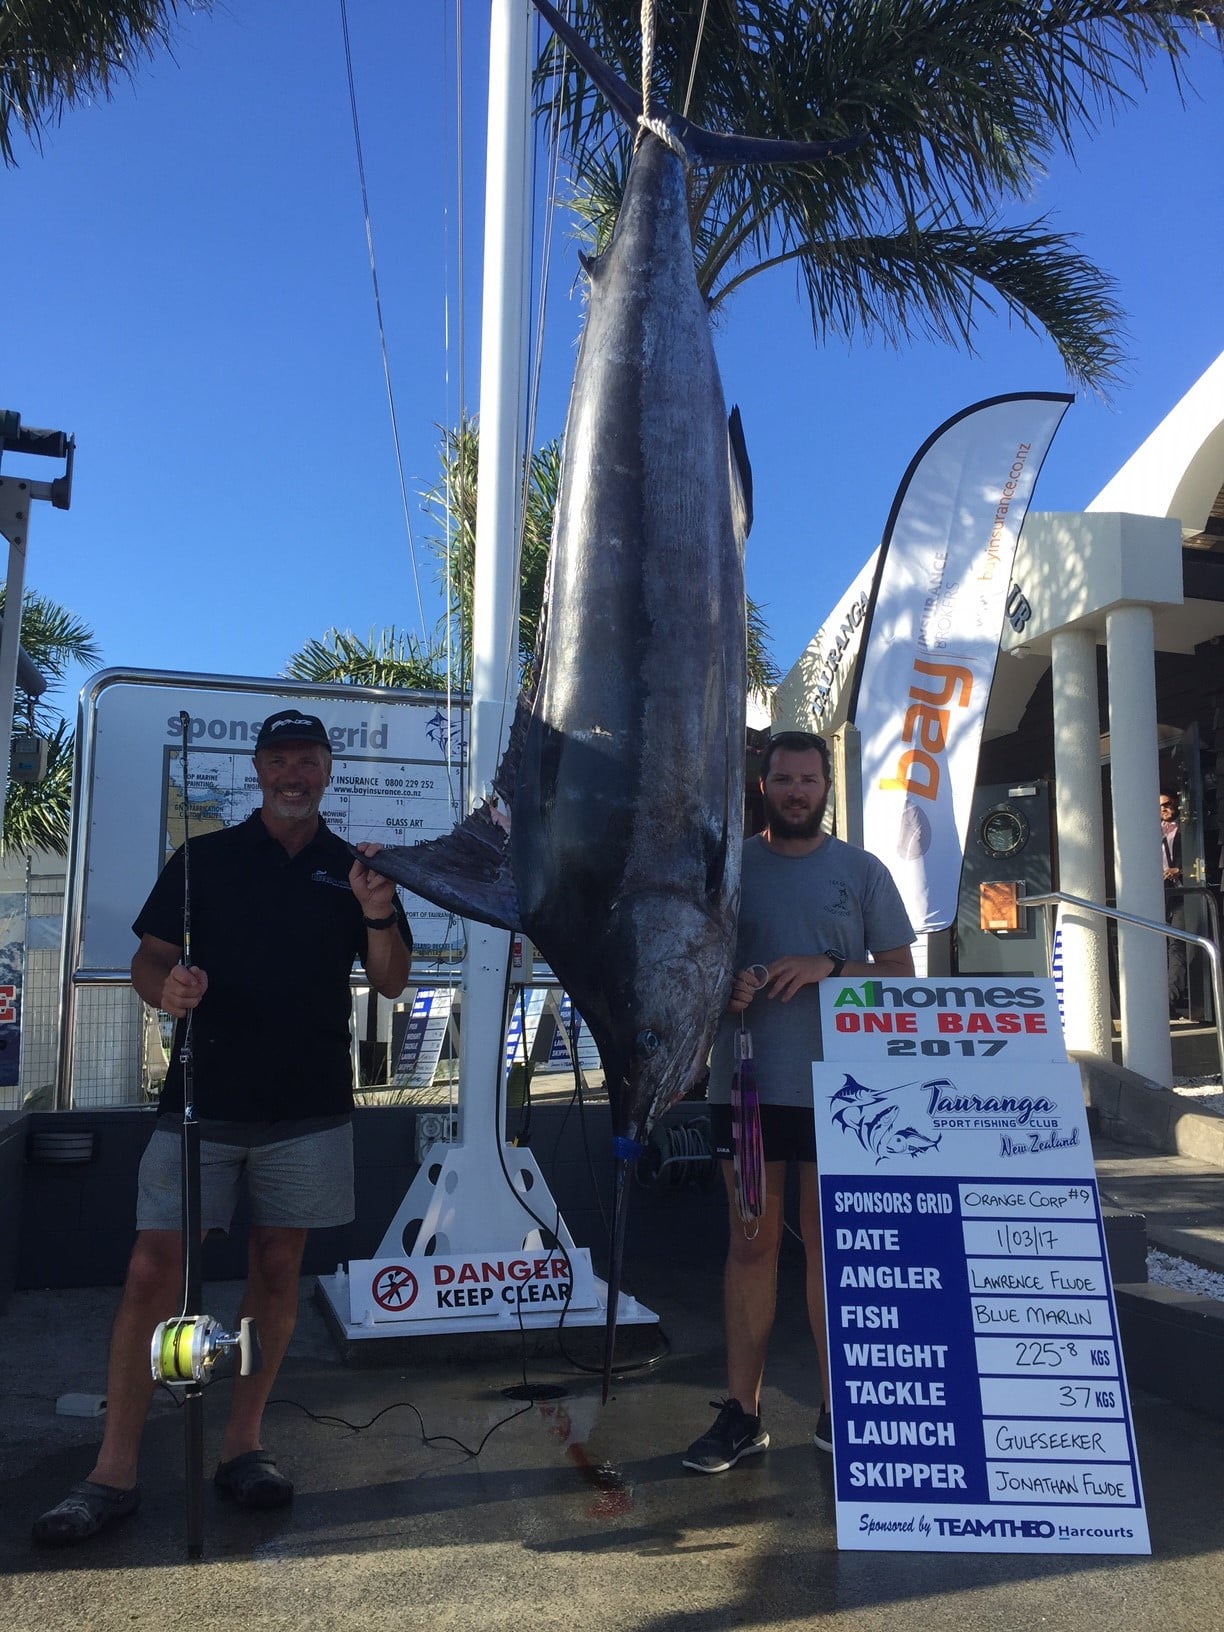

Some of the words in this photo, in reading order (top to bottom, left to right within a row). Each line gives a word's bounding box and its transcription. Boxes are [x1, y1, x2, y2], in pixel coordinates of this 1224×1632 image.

[918, 551, 949, 649] INSURANCE
[933, 582, 960, 649] BROKERS
[812, 590, 870, 717] TAURANGA
[328, 721, 388, 752] grid
[879, 658, 974, 801] bay
[333, 786, 422, 797] www.bayinsurance.co.nz
[337, 776, 379, 786] INSURANCE
[385, 778, 403, 787] 0800
[405, 779, 419, 788] 229
[420, 780, 434, 789] 252
[385, 818, 408, 827] GLASS
[410, 819, 424, 828] ART
[835, 1012, 918, 1033] ONE
[937, 1012, 1048, 1034] BASE
[887, 1039, 1008, 1057] 2017
[920, 1078, 1057, 1125] Tauranga
[933, 1119, 970, 1128] SPORT
[973, 1119, 1017, 1128] FISHING
[1029, 1119, 1059, 1128] CLUB
[1000, 1132, 1027, 1157] New
[1027, 1127, 1080, 1153] Zealand
[834, 1191, 912, 1214] SPONSORS
[916, 1192, 953, 1215] GRID
[836, 1228, 900, 1250] DATE
[996, 1224, 1059, 1255] 1/03/17
[433, 1259, 570, 1286] DANGER
[839, 1266, 943, 1290] ANGLER
[970, 1268, 1044, 1290] LAWRENCE
[1051, 1270, 1096, 1292] FLUDE
[436, 1287, 494, 1309] KEEP
[501, 1282, 572, 1306] CLEAR
[841, 1305, 899, 1329] FISH
[974, 1304, 1020, 1325] BLUE
[1026, 1306, 1092, 1326] MARLIN
[843, 1343, 949, 1368] WEIGHT
[1091, 1349, 1111, 1367] KGS
[845, 1380, 946, 1406] TACKLE
[1058, 1385, 1091, 1409] 37
[1095, 1391, 1116, 1409] KGS
[847, 1419, 956, 1447] LAUNCH
[996, 1425, 1106, 1453] GULFSEEKER
[849, 1461, 968, 1489] SKIPPER
[995, 1470, 1078, 1495] JONATHAN
[1083, 1472, 1127, 1498] FLUDE
[858, 1512, 915, 1534] Sponsored
[918, 1513, 931, 1538] by
[1058, 1524, 1134, 1539] Harcourts
